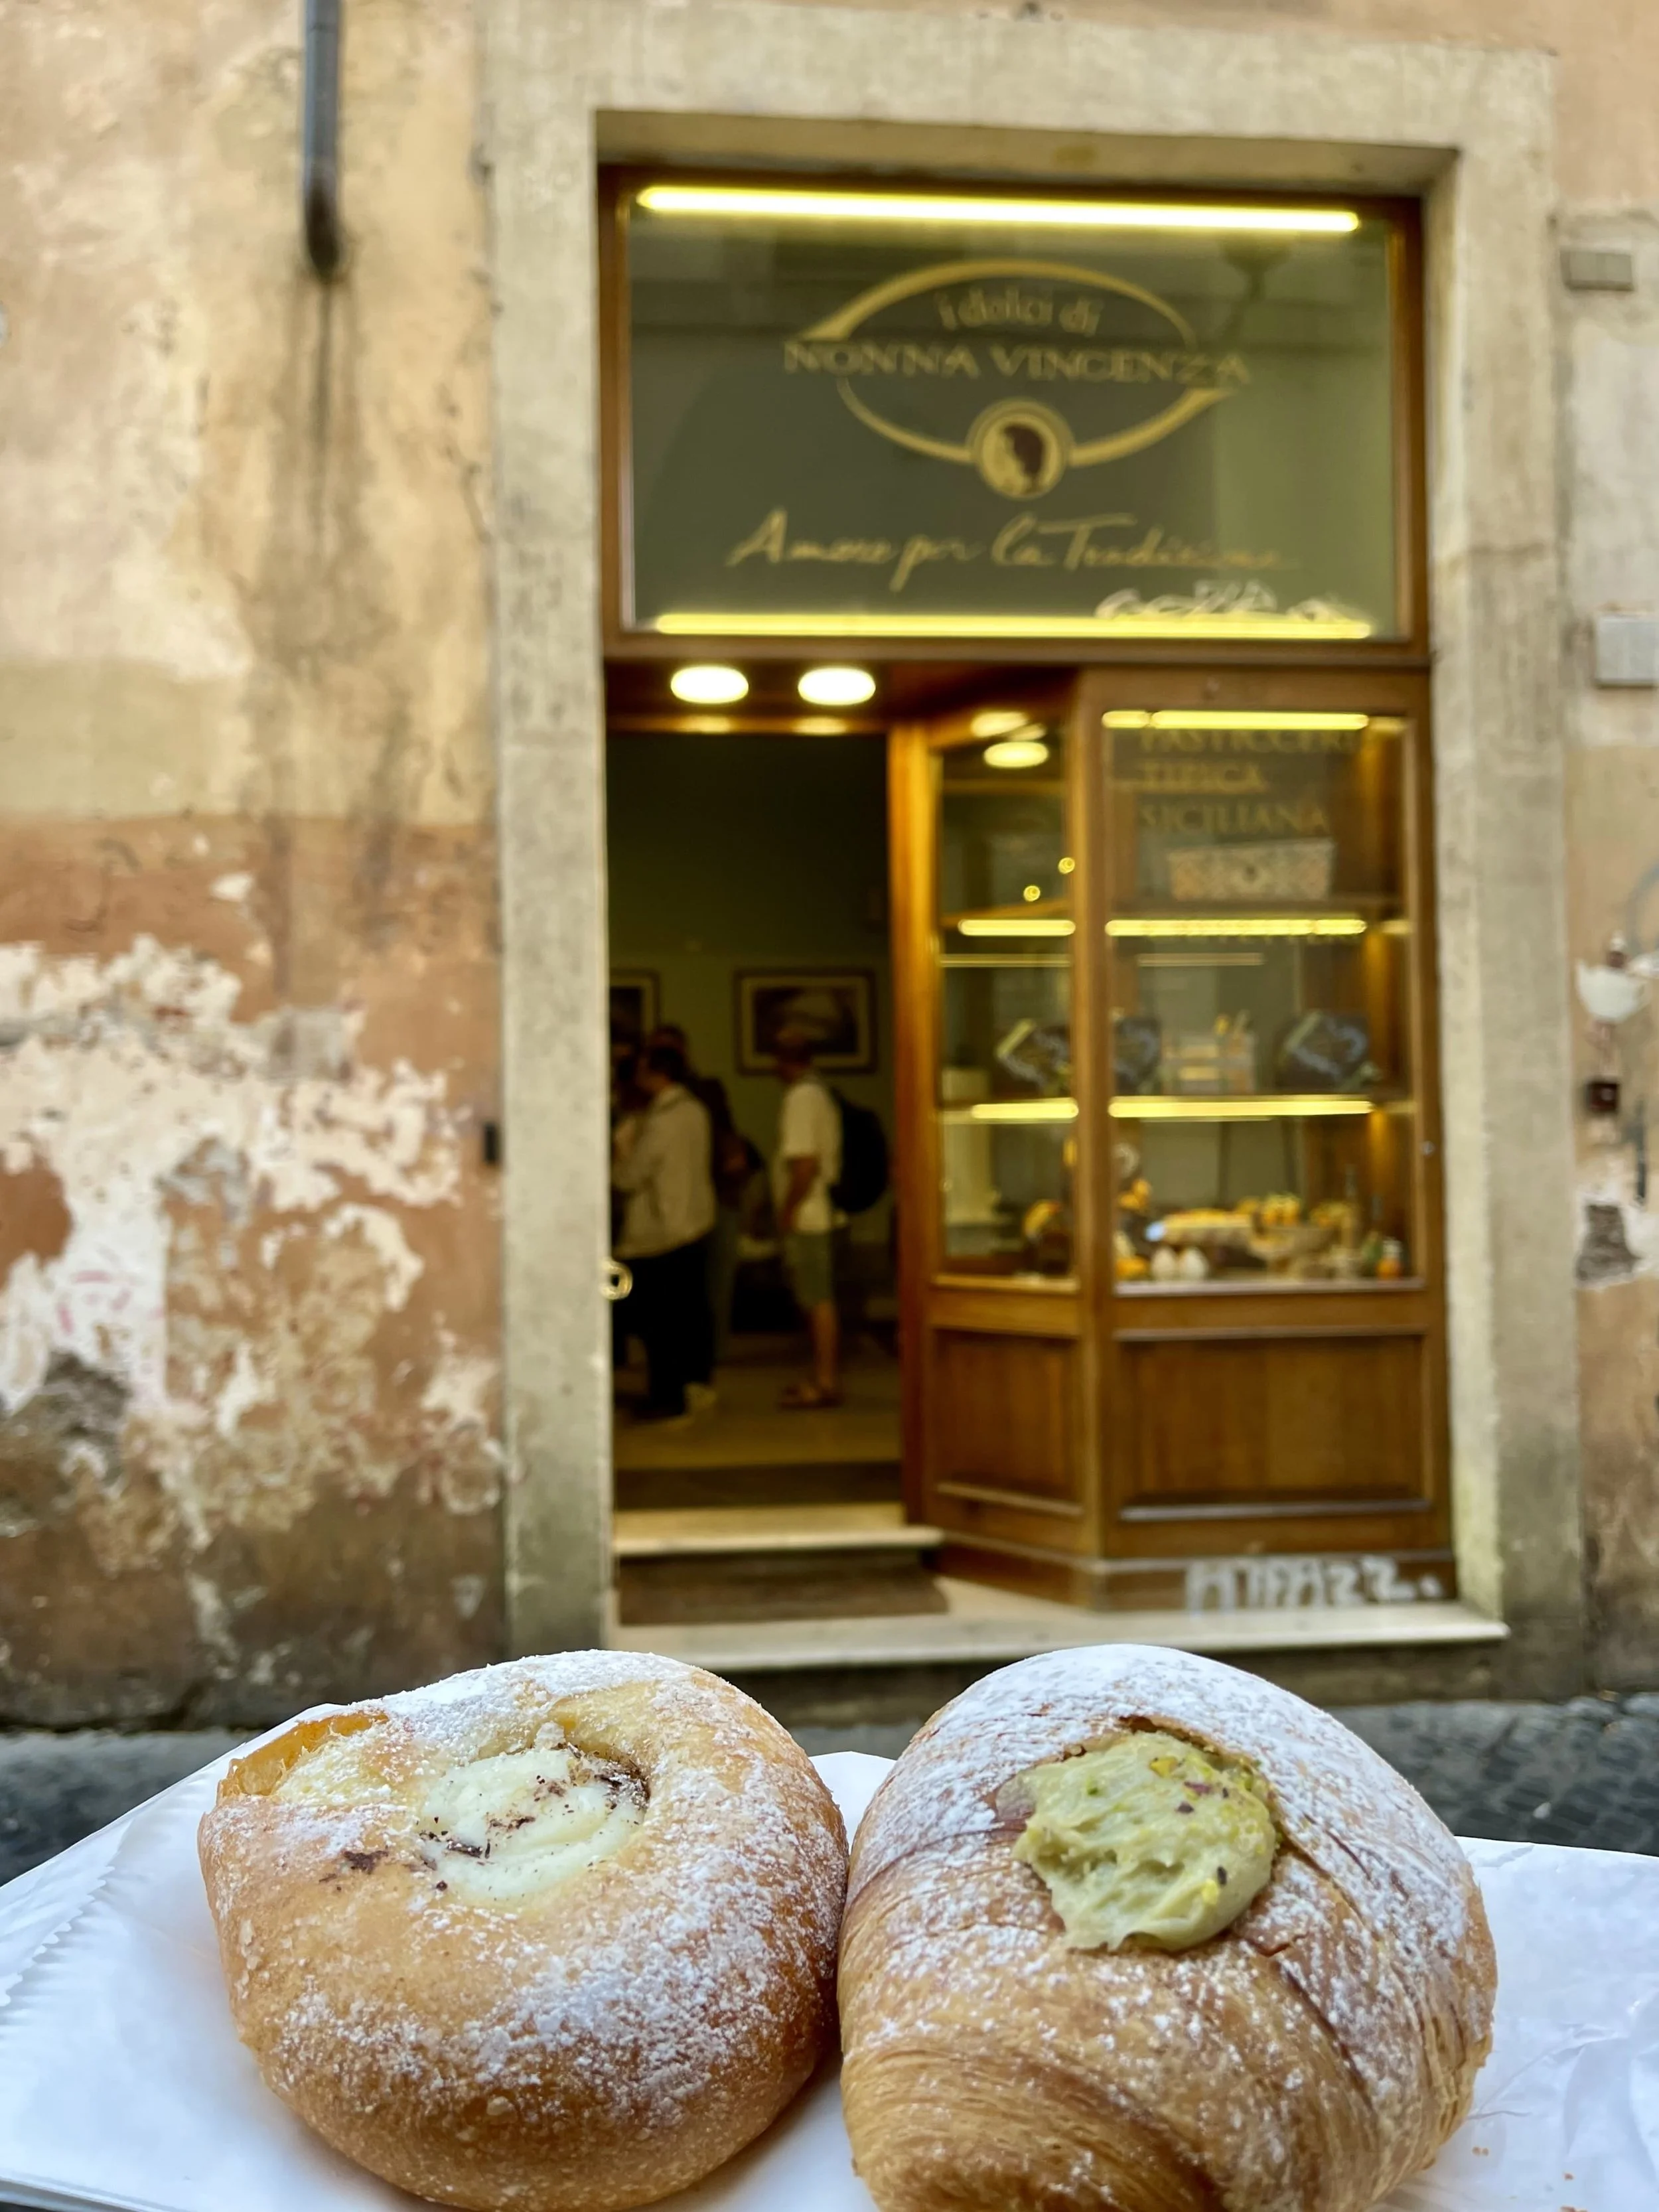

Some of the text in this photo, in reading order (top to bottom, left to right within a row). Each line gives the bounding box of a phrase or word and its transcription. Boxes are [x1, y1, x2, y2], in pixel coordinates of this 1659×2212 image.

[960, 284, 1054, 328] dolci
[1059, 297, 1104, 336] di
[783, 340, 1250, 386] NONNA VINCENZA
